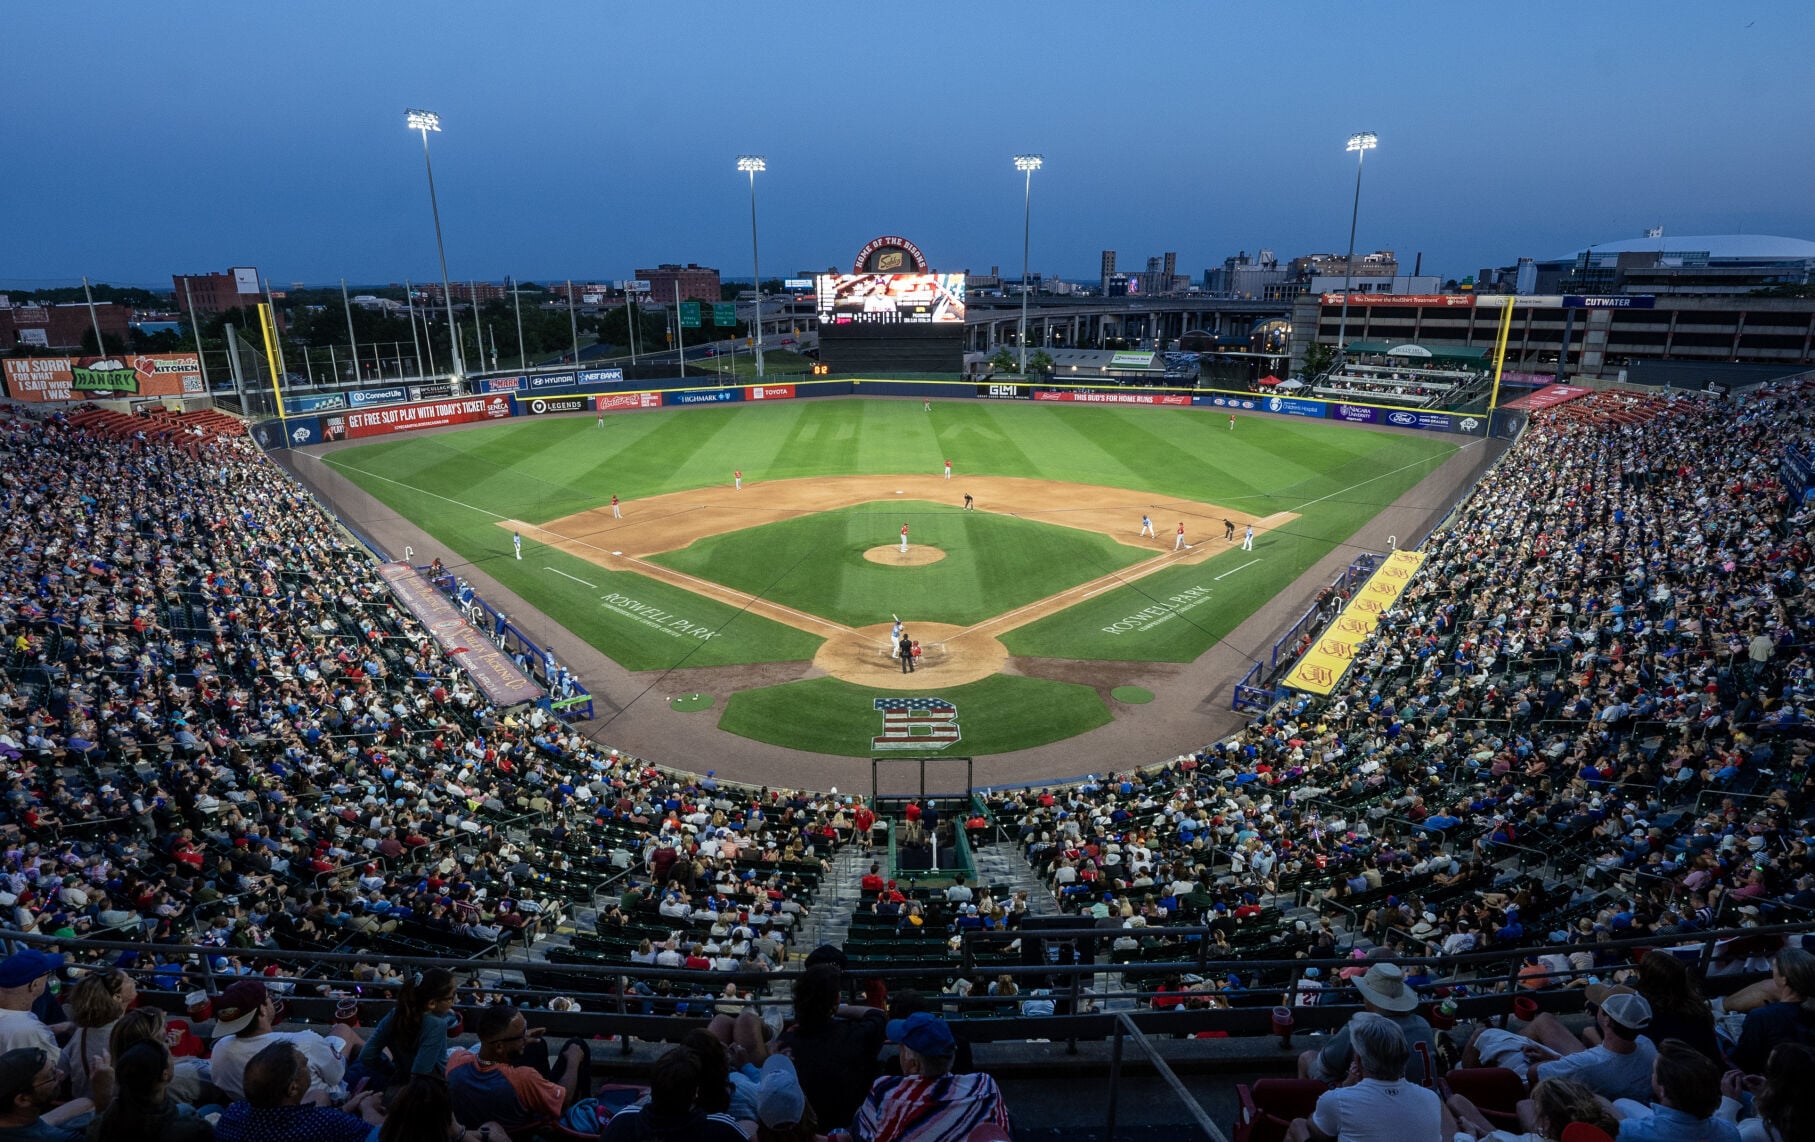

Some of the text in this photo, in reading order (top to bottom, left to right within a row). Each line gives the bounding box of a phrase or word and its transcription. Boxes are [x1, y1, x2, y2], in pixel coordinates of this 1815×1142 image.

[856, 237, 926, 268] HOME OF THE BISONS
[1585, 298, 1630, 306] CUTWATER
[7, 360, 72, 373] I'M SORRY
[154, 365, 198, 373] KITCHEN
[12, 372, 54, 382] FOR WHAT
[77, 373, 132, 386] HANGRY
[544, 376, 573, 384] HYUNDAI
[585, 371, 621, 380] NBT BANK
[18, 381, 73, 391] I SAID WHEN
[989, 385, 1017, 396] GLMI
[42, 390, 71, 400] I WAS
[682, 395, 718, 403] HIGHMARK
[1088, 394, 1105, 402] BUD'S
[1118, 395, 1136, 403] HOME
[548, 401, 582, 410] LEGENDS
[1349, 406, 1371, 414] NIAGARA
[349, 415, 363, 428] GET
[364, 413, 383, 426] FREE
[382, 410, 398, 424] SLOT
[400, 408, 417, 421] PLAY
[417, 405, 435, 419] WITH
[435, 402, 462, 417] TODAY'S
[462, 400, 486, 414] TICKET!
[1393, 413, 1412, 423] Ford
[1102, 585, 1213, 635] ROSWELL PARK
[600, 592, 721, 641] ROSWELL PARK
[479, 652, 514, 681] PACKING
[871, 698, 962, 751] B
